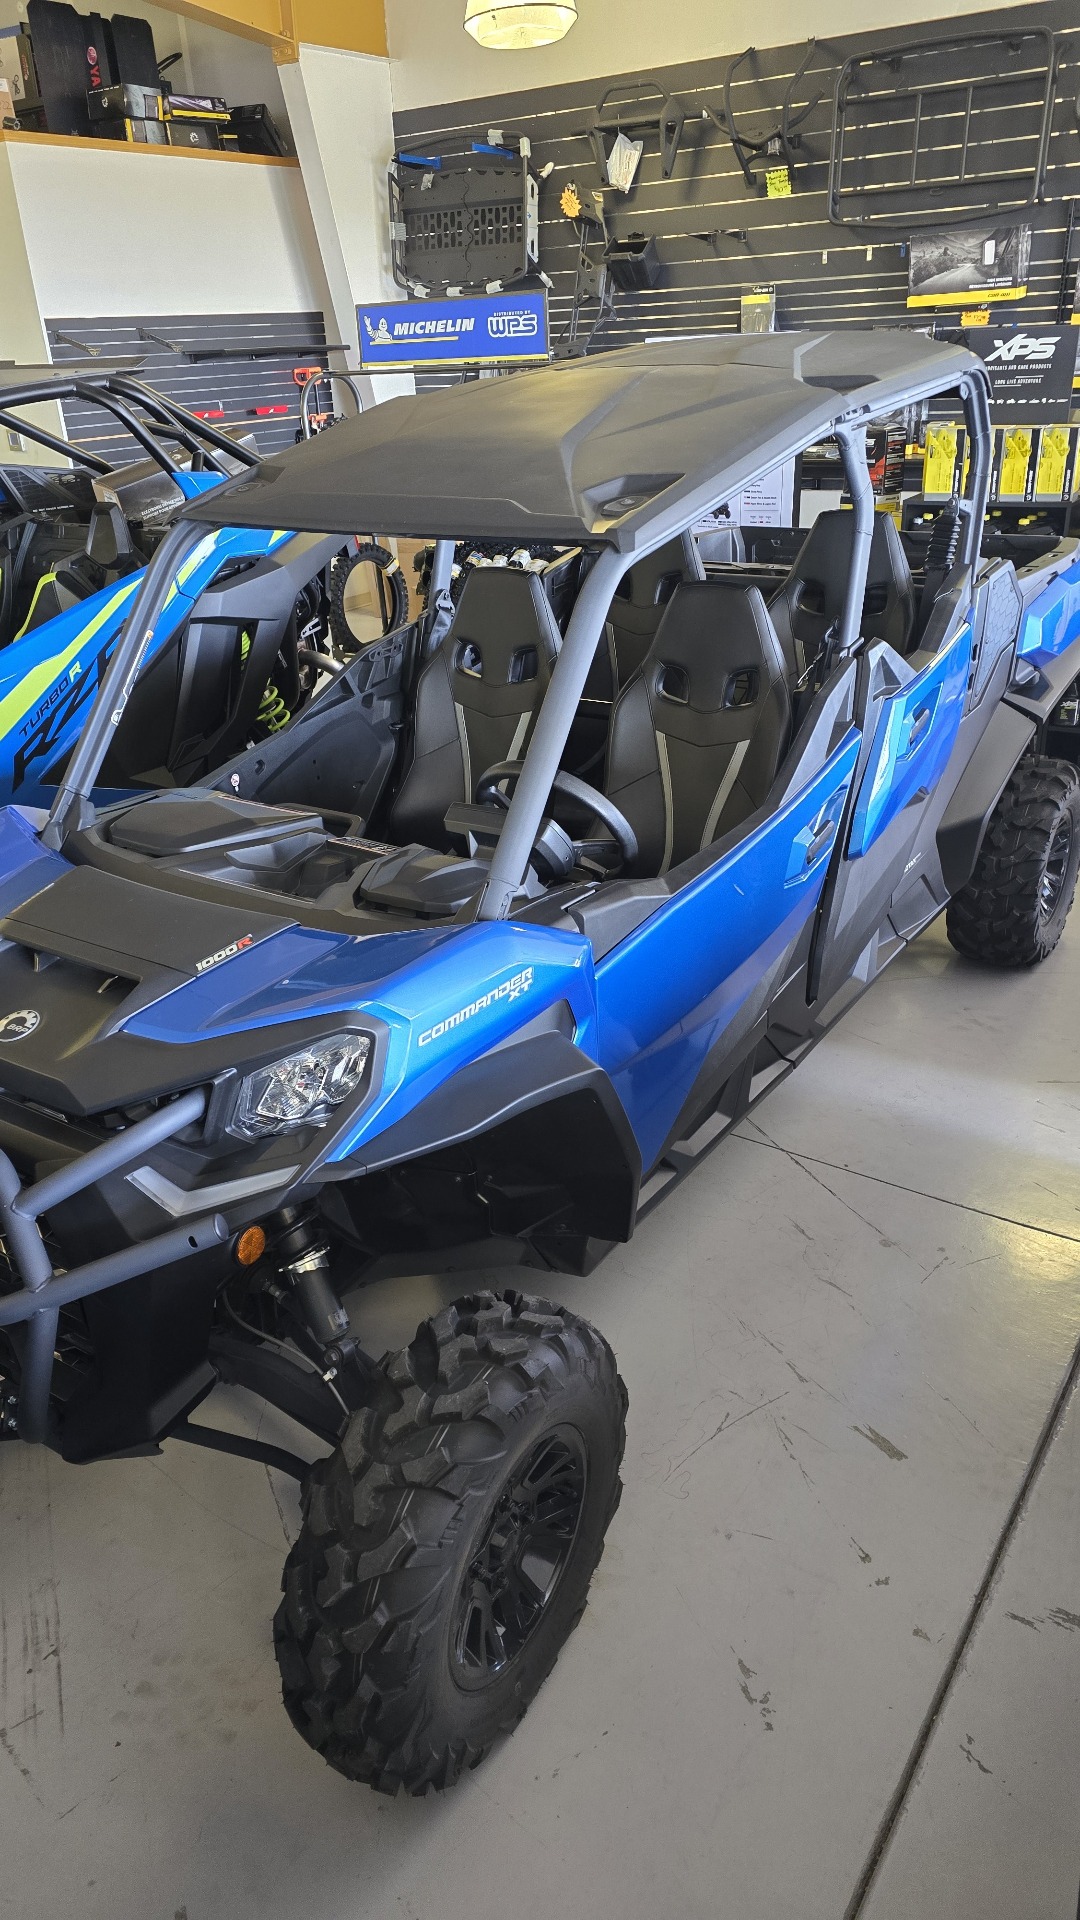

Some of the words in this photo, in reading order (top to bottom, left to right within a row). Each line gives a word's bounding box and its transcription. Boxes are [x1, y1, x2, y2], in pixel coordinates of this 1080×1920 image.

[393, 317, 475, 336] MICHELIN
[487, 314, 537, 337] WPS
[983, 333, 1062, 362] XPS
[19, 675, 70, 738] TURBO
[68, 660, 83, 684] R
[195, 933, 254, 972] 1000R
[508, 979, 533, 1002] XT
[417, 965, 534, 1048] COMMANDER
[6, 1023, 30, 1033] BRP
